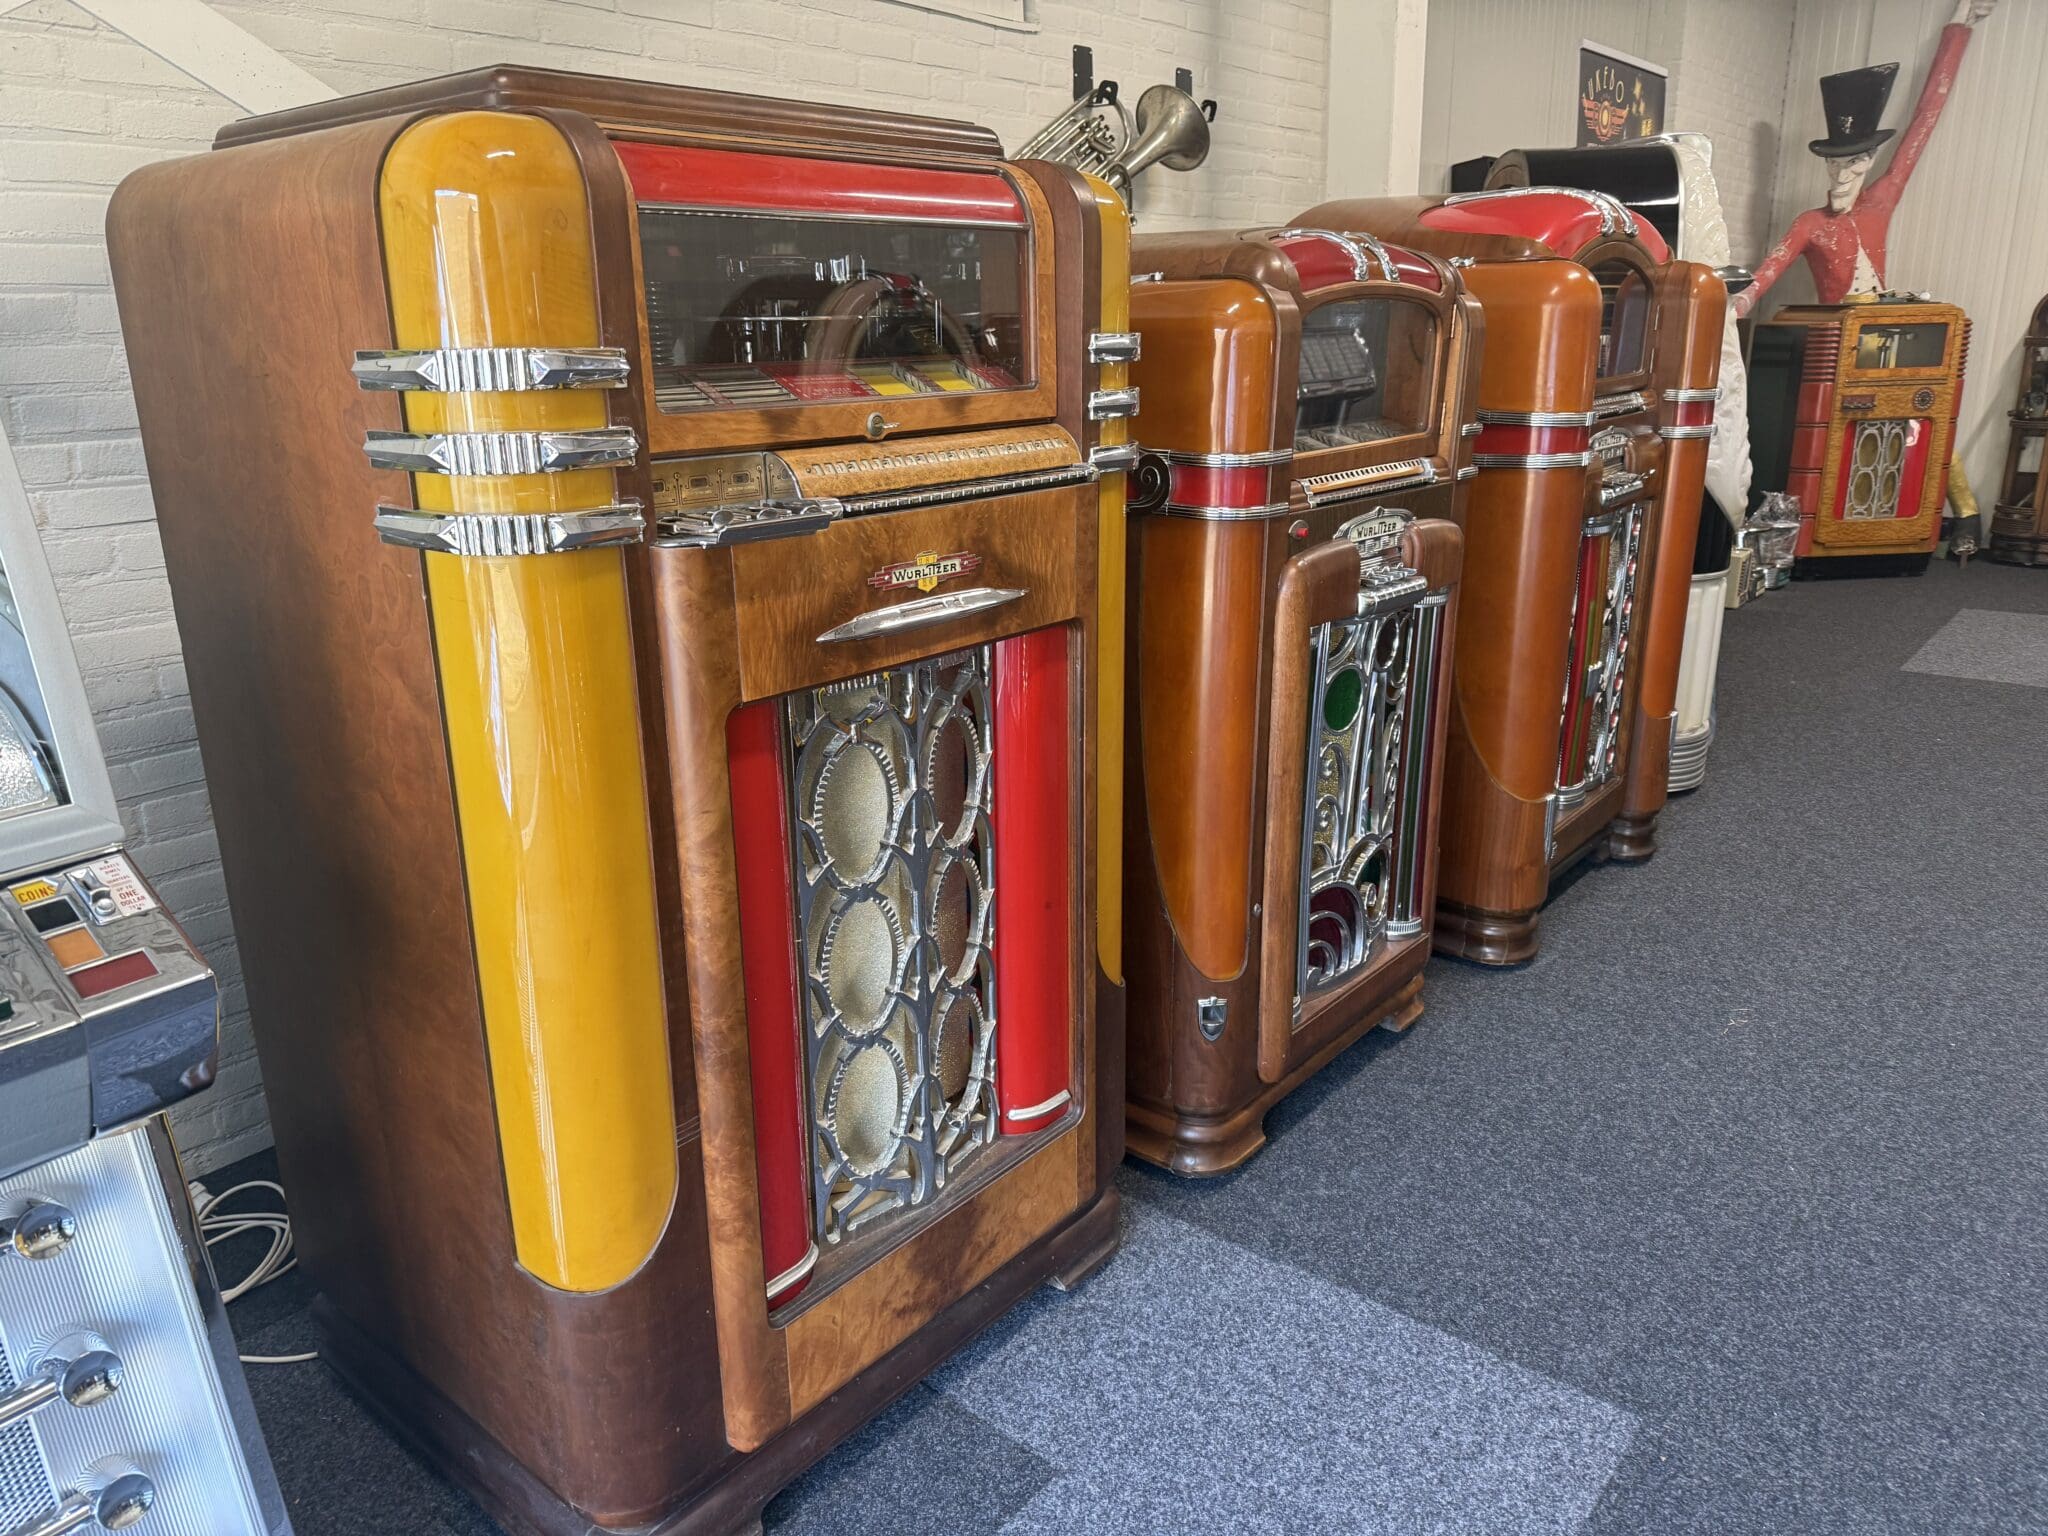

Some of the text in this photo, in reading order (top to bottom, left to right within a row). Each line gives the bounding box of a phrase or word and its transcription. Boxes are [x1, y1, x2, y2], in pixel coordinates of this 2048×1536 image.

[1356, 521, 1397, 538] WURLITZER
[893, 562, 957, 582] WURLITZER
[18, 885, 57, 903] COINS
[119, 889, 139, 900] ONE
[120, 895, 146, 907] DOLLAR
